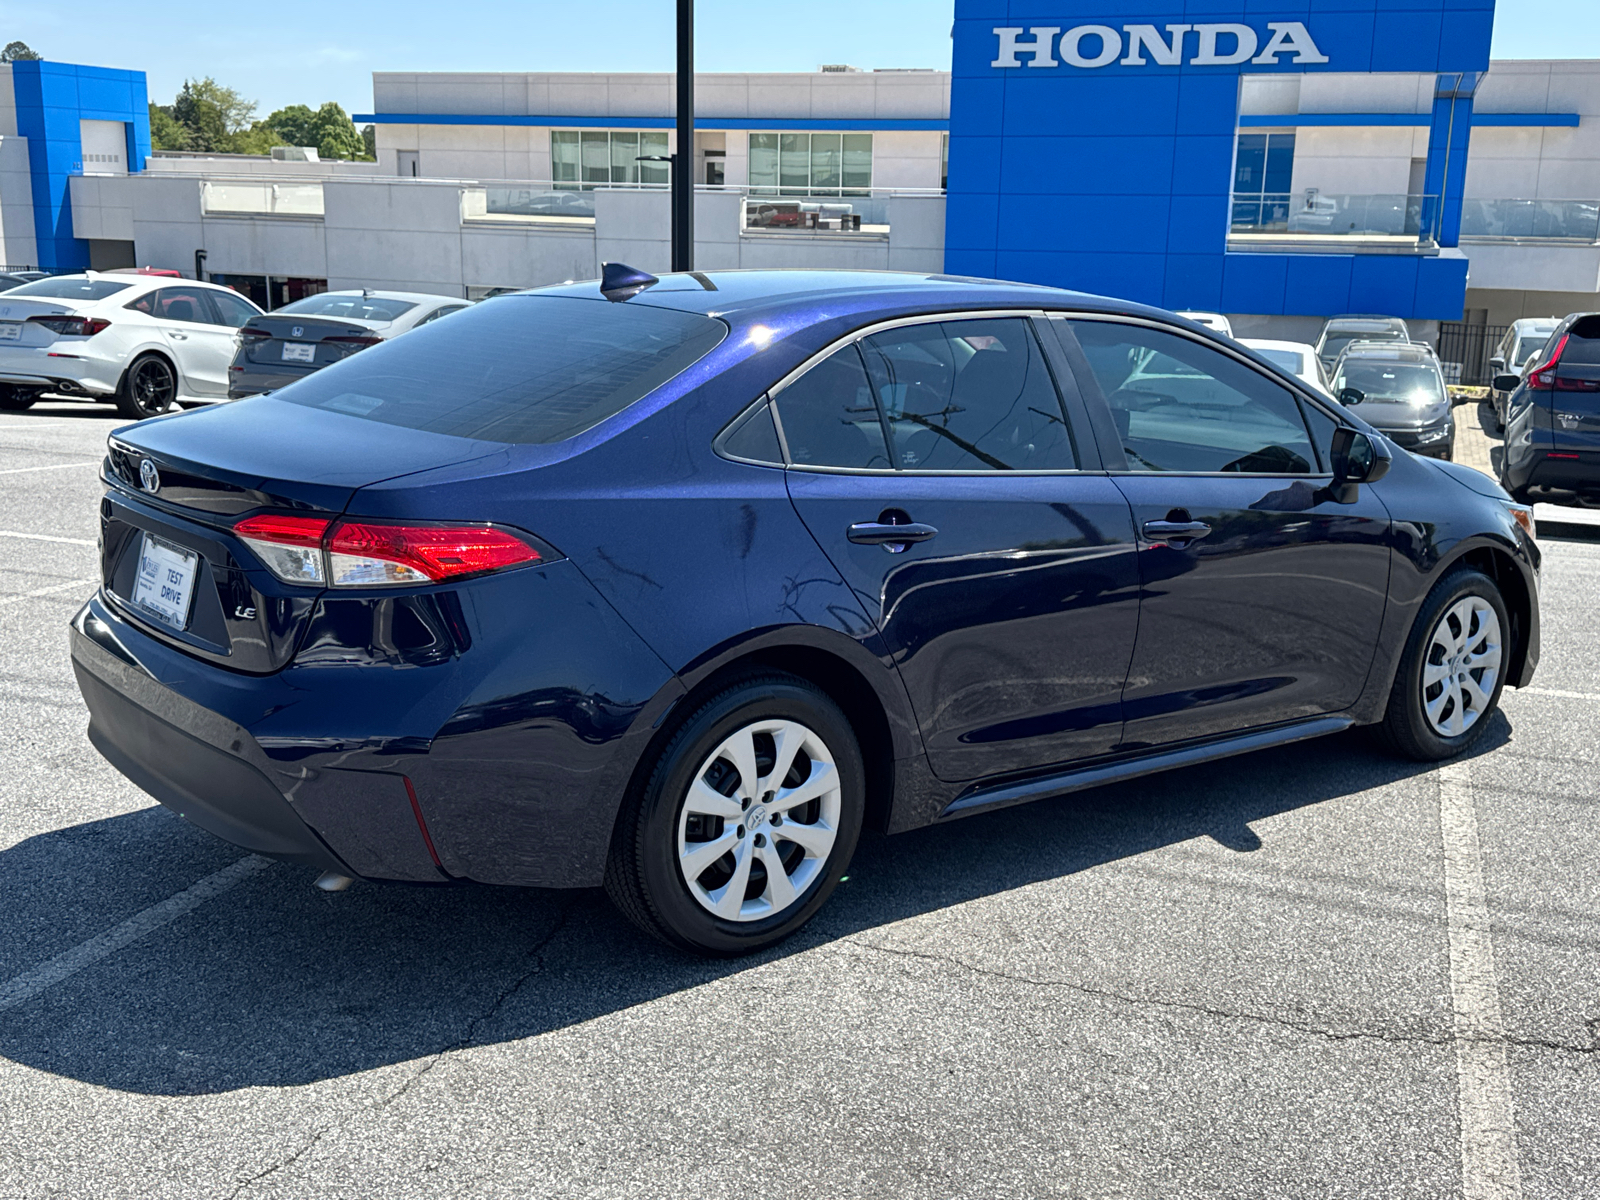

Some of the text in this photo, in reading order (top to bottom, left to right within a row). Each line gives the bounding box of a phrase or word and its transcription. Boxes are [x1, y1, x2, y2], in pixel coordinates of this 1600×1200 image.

[991, 21, 1329, 68] HONDA
[167, 568, 183, 586] TEST
[161, 585, 182, 605] DRIVE
[235, 605, 256, 619] LE
